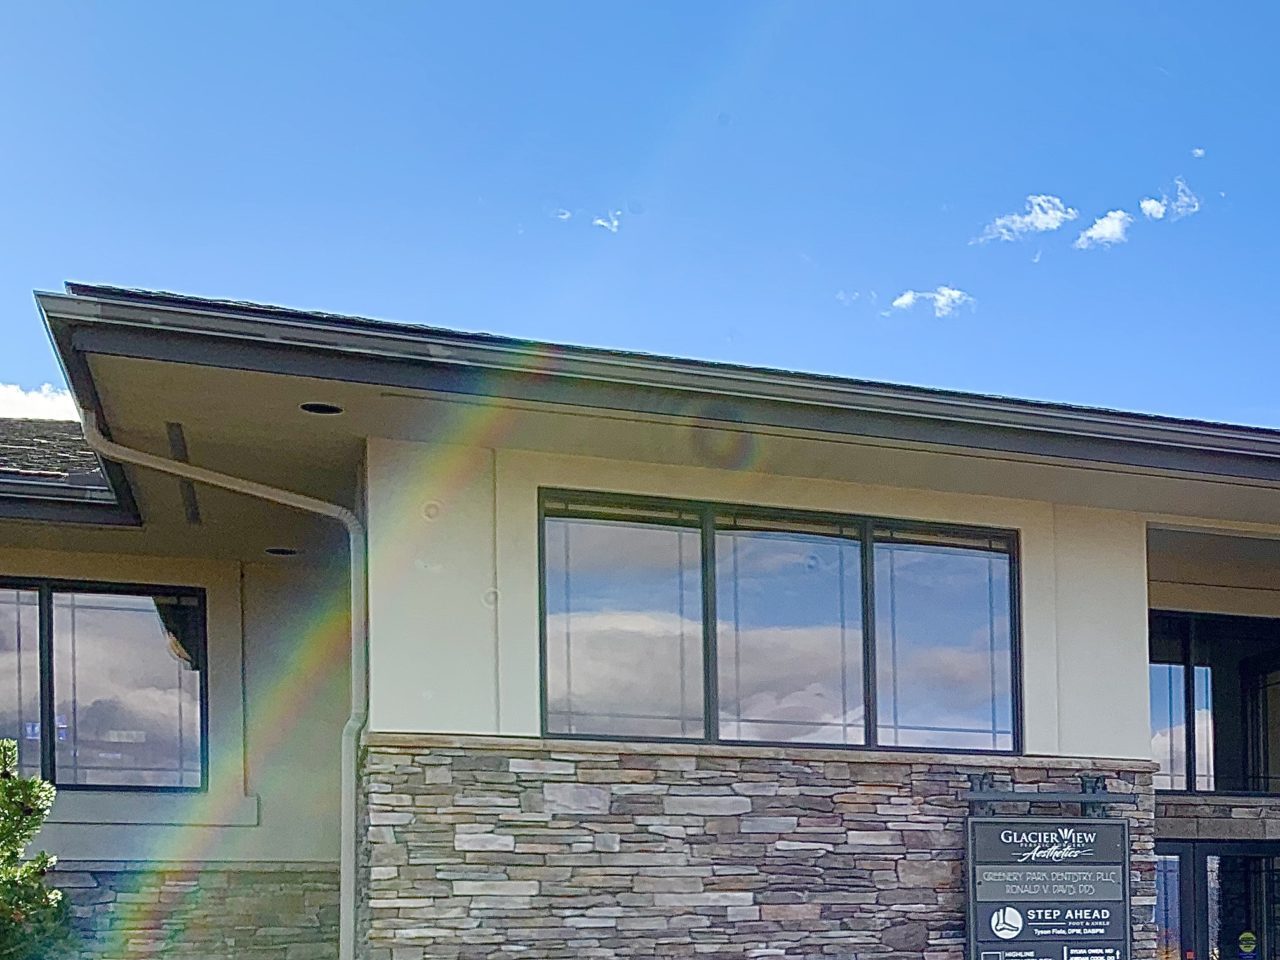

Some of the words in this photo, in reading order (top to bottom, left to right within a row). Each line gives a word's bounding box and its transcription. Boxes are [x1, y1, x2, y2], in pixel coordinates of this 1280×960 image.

[1017, 845, 1088, 862] Aesthetics
[1026, 871, 1049, 881] PARK
[1005, 884, 1040, 894] RONALD
[1027, 909, 1061, 920] STEP
[1065, 909, 1110, 920] AHEAD
[1034, 928, 1051, 936] Tyson
